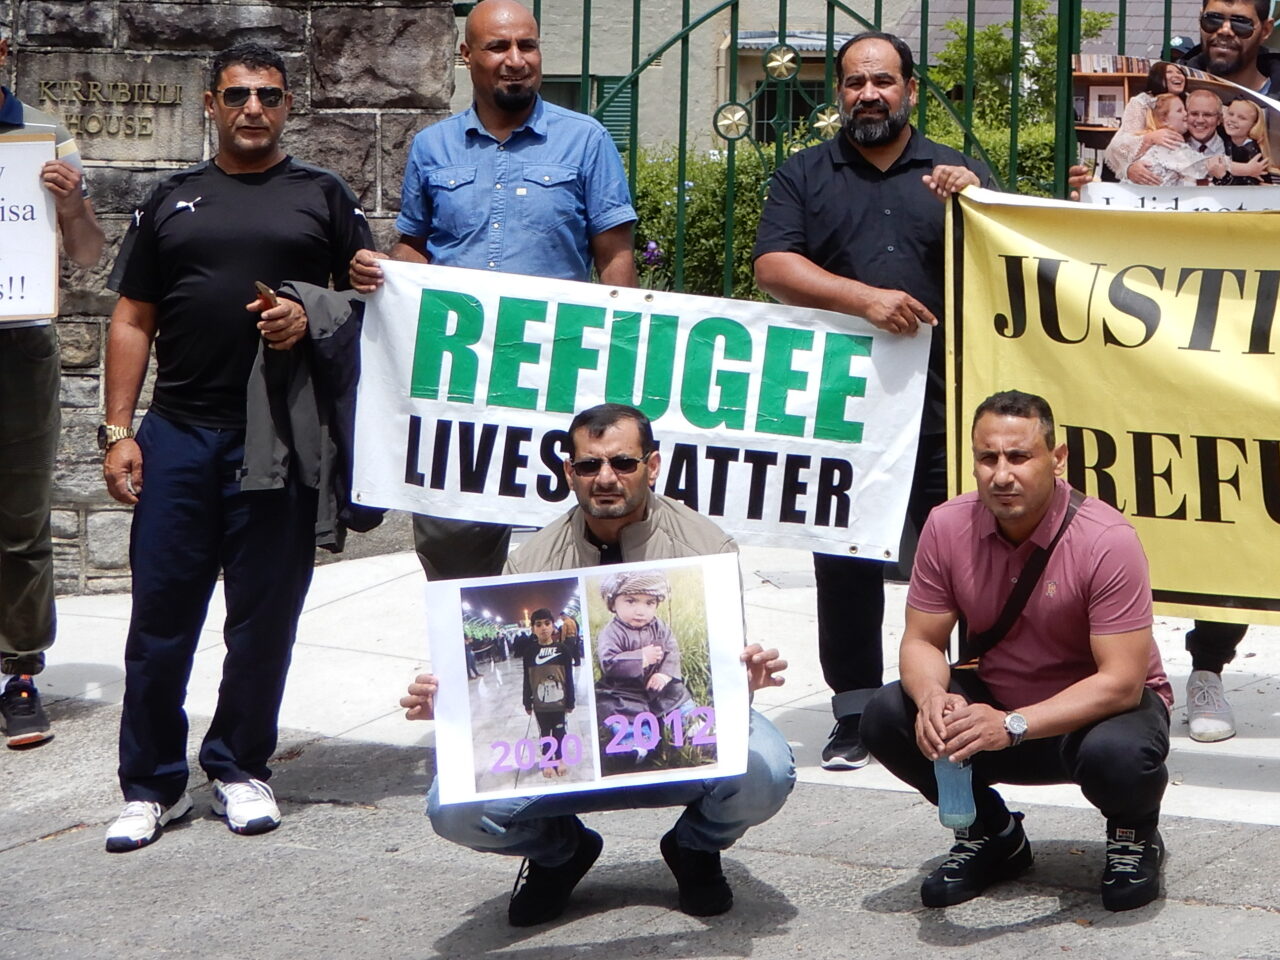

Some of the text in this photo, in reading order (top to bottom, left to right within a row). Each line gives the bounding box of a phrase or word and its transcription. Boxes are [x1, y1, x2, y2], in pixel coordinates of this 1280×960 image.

[39, 80, 183, 104] KIRRIBILLI
[64, 114, 153, 136] HOUSE
[410, 288, 874, 442] REFUGEE
[405, 415, 853, 528] LIVES ATTER
[539, 646, 558, 656] NIKE
[604, 707, 716, 754] 2012
[491, 734, 583, 773] 2020
